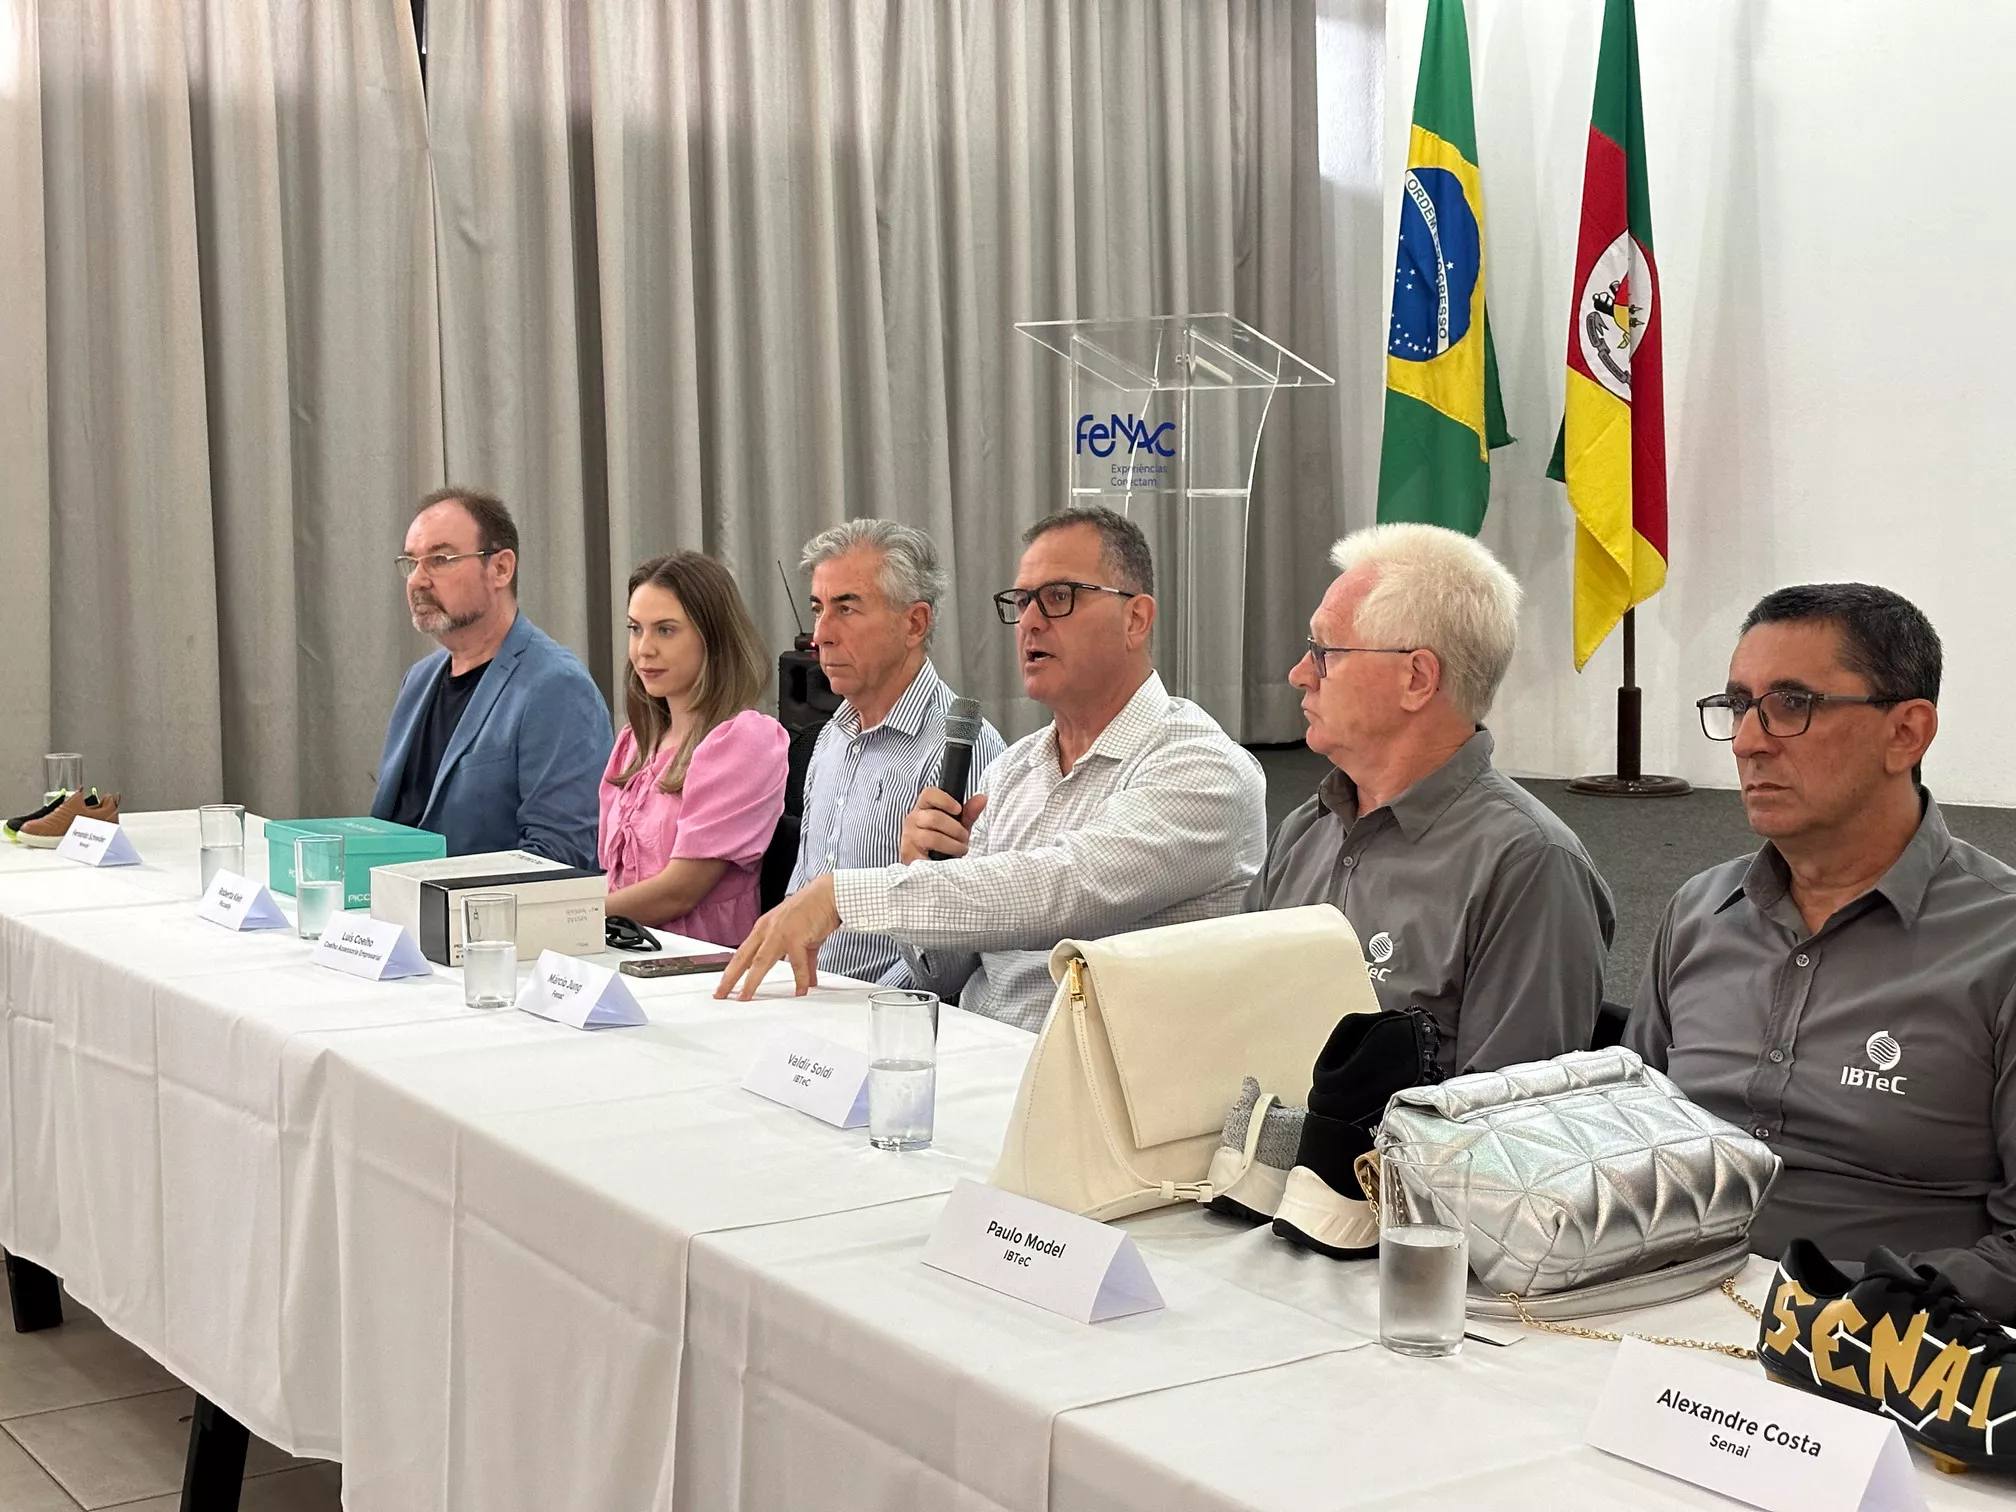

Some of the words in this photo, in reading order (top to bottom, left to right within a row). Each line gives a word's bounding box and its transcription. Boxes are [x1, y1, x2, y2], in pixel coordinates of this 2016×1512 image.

[1407, 178, 1437, 230] ORDEM
[548, 973, 567, 988] Márcio
[566, 979, 583, 994] Jung
[787, 1053, 811, 1071] Valdir
[810, 1062, 834, 1080] Soldi
[792, 1074, 812, 1087] IBTeC
[1840, 1066, 1907, 1095] IBTeC
[986, 1220, 1023, 1244] Paulo
[1024, 1232, 1067, 1259] Model
[1003, 1249, 1032, 1267] IBTeC
[1764, 1279, 2002, 1430] SENAI
[1656, 1388, 1759, 1436] Alexandre
[1763, 1423, 1822, 1458] Costa
[1709, 1434, 1751, 1459] Senai
